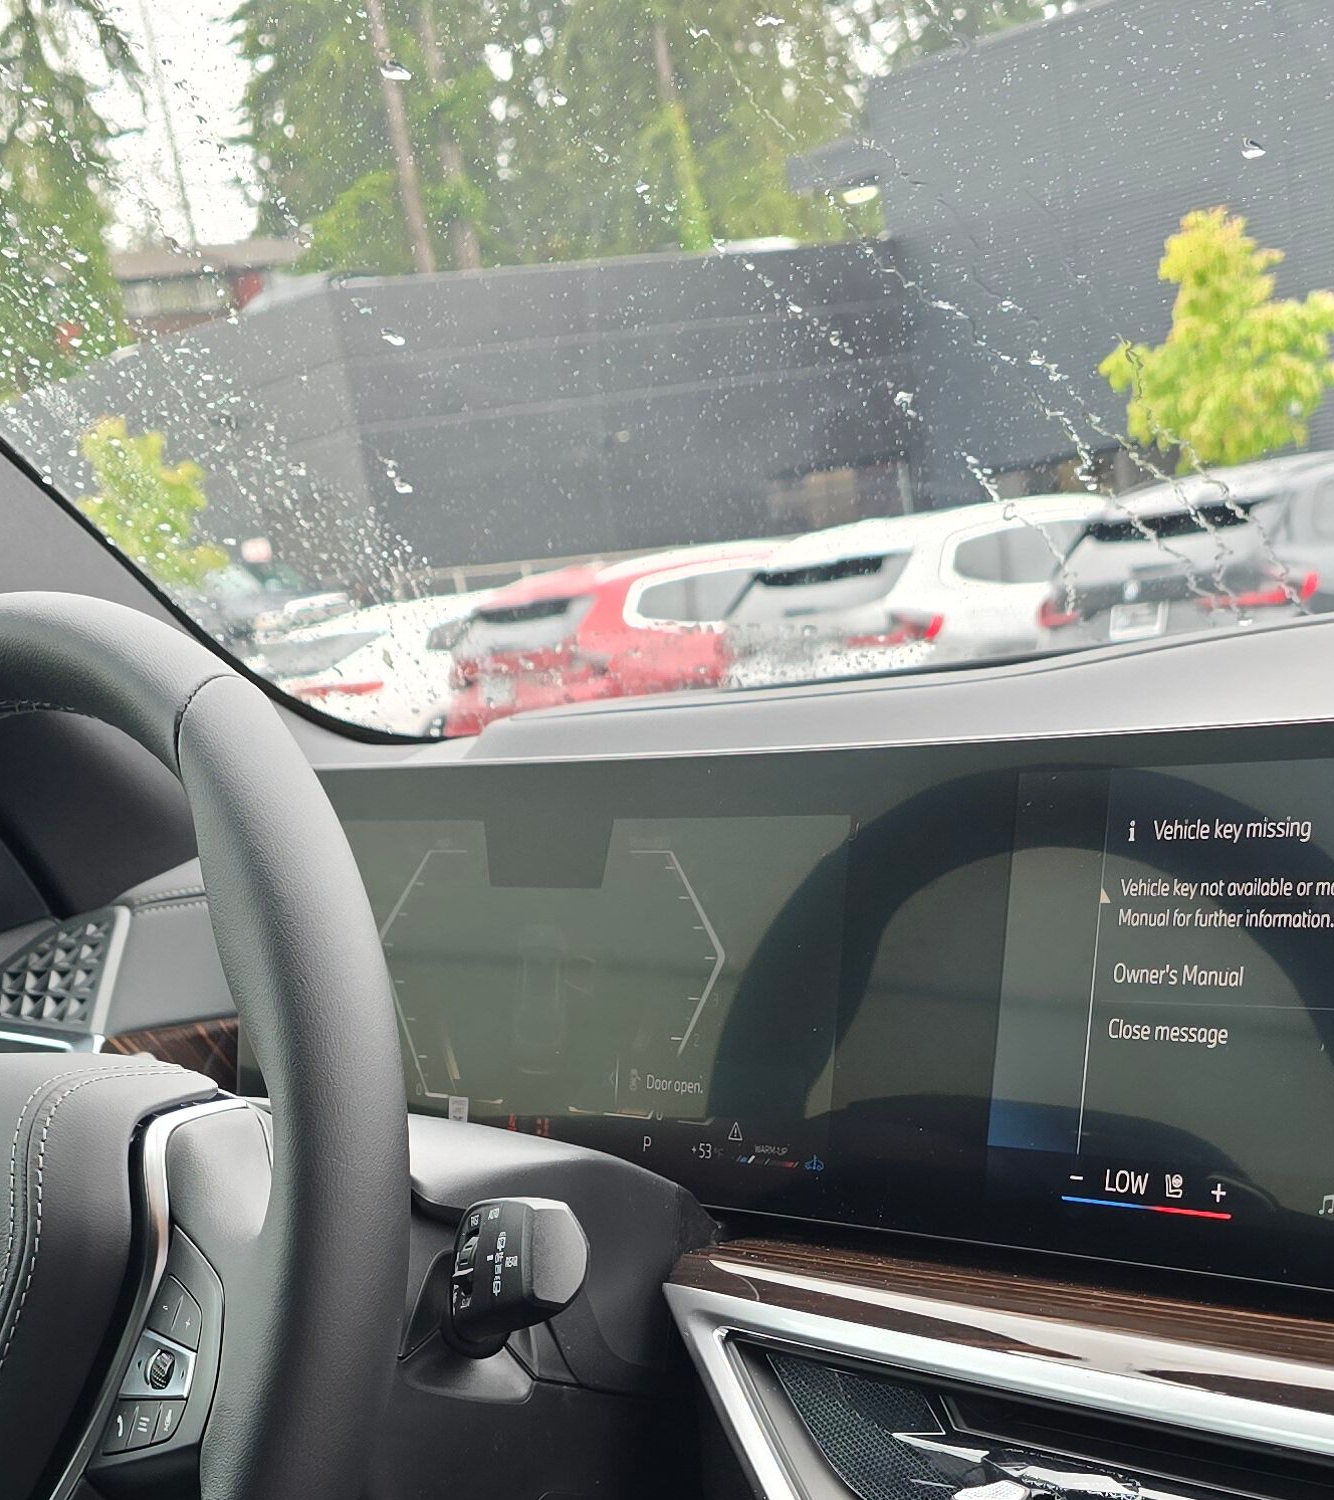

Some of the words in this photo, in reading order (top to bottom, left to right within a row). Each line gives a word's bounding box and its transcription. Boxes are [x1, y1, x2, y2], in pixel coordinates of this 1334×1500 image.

[1154, 818, 1210, 841] Vehicle
[1213, 818, 1243, 843] key
[1246, 816, 1312, 843] missing
[1121, 878, 1169, 897] Vehicle
[1173, 878, 1198, 900] key
[1200, 879, 1224, 897] not
[1227, 877, 1293, 897] available
[1296, 880, 1313, 897] or
[1118, 908, 1169, 928] Manual
[1172, 908, 1193, 927] for
[1194, 908, 1244, 928] further
[1246, 908, 1334, 929] information.
[1113, 962, 1178, 986] Owner's
[1182, 964, 1245, 988] Manual
[1108, 1018, 1151, 1041] Close
[1154, 1024, 1229, 1049] message
[646, 1074, 674, 1091] Door
[674, 1080, 703, 1096] open.
[642, 1135, 652, 1152] P
[1105, 1168, 1149, 1195] LOW
